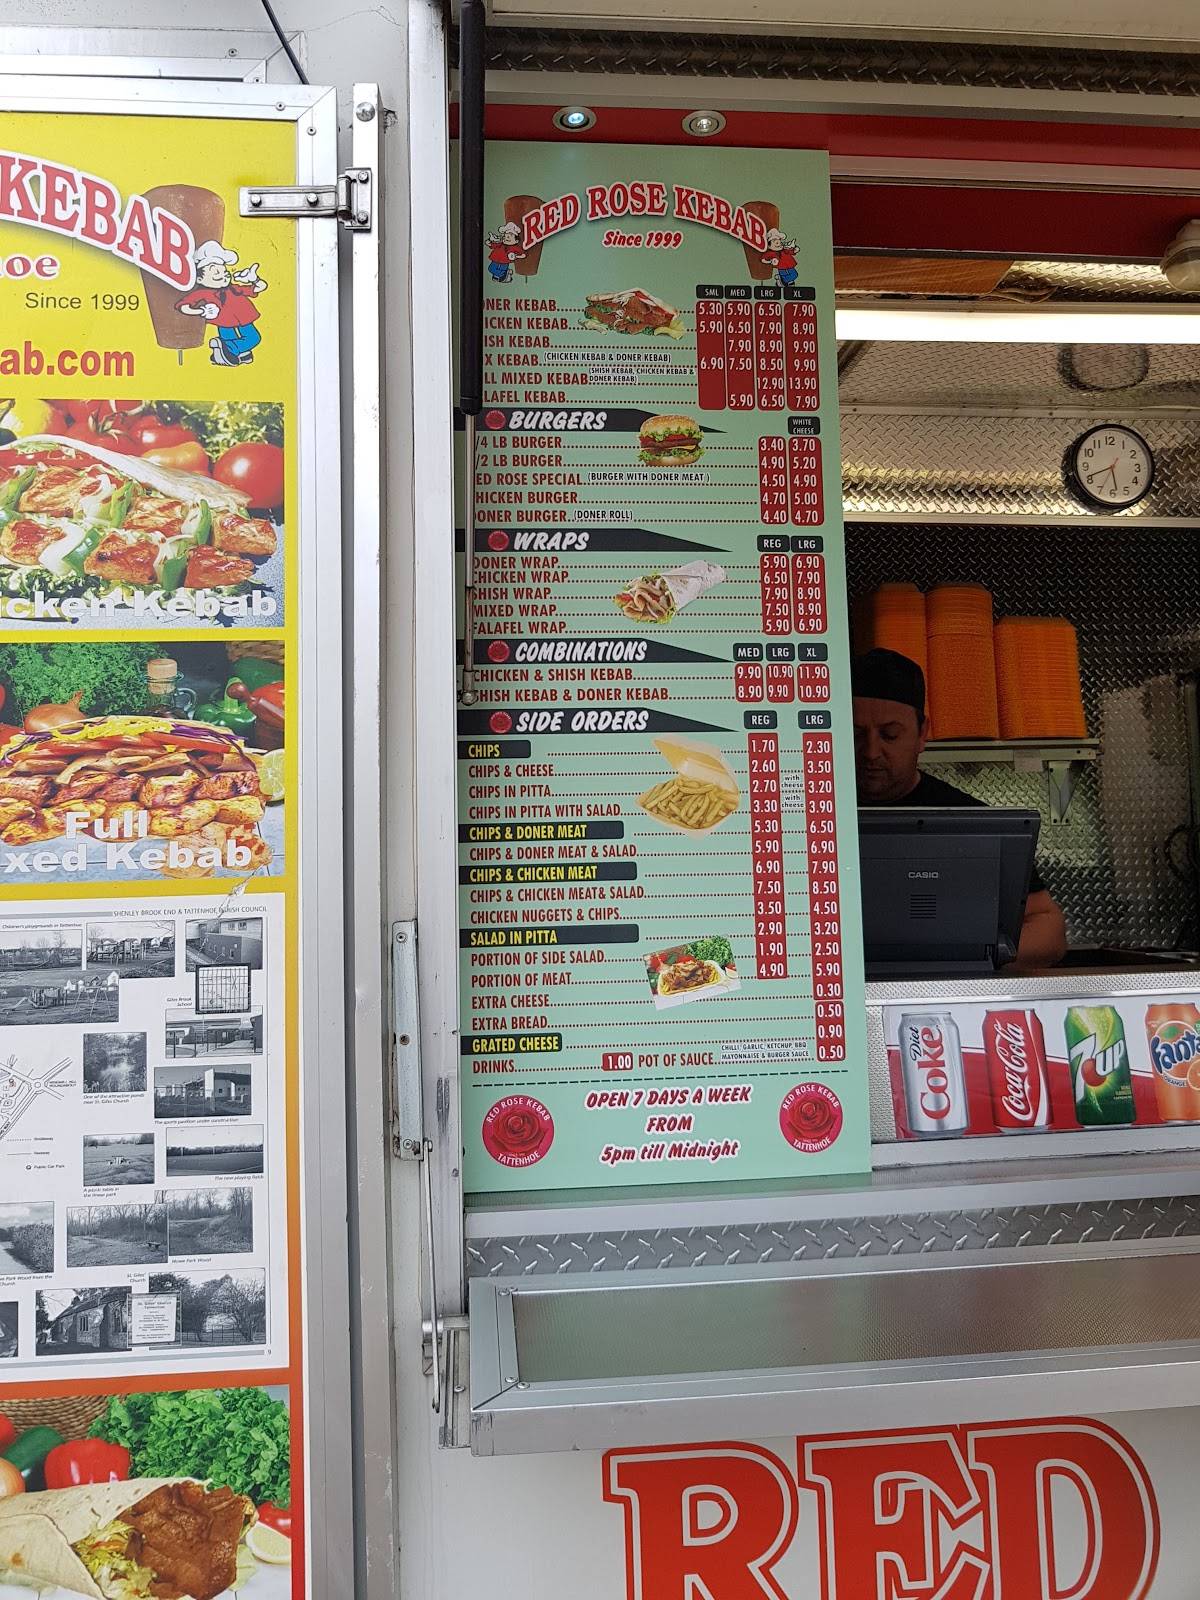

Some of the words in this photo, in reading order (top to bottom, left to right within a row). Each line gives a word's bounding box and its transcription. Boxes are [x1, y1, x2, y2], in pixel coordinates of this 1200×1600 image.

[0, 154, 191, 287] KEBAB
[523, 194, 581, 248] RED
[587, 182, 667, 219] ROSE
[674, 185, 767, 251] KEBAB
[604, 231, 641, 246] Since
[646, 232, 682, 247] 1999
[705, 288, 719, 296] SML
[731, 289, 745, 297] MED
[793, 290, 802, 298] XL
[25, 292, 81, 308] Since
[91, 294, 139, 310] 1999
[699, 303, 722, 315] 5.30
[727, 303, 750, 315] 5.90
[759, 304, 781, 316] 6.50
[792, 305, 814, 316] 7.90
[729, 340, 751, 352] 7.90
[760, 340, 782, 352] 8.90
[794, 341, 815, 353] 9.90
[544, 352, 578, 362] (CHICKEN
[581, 353, 605, 361] KEBAB
[608, 353, 613, 361] &
[616, 353, 642, 361] DONER
[644, 354, 670, 363] KEBAB)
[502, 372, 542, 384] MIXED
[548, 373, 588, 385] KEBAB
[757, 378, 784, 390] 12.90
[789, 378, 816, 390] 13.90
[509, 410, 607, 430] BURGERS
[493, 436, 507, 448] LB
[512, 436, 562, 449] BURGER
[760, 438, 784, 451] 3.40
[792, 439, 815, 451] 3.70
[1105, 436, 1115, 445] 12
[1084, 448, 1093, 457] 10
[497, 473, 528, 485] ROSE
[532, 473, 582, 486] SPECIAL
[588, 473, 624, 482] (BURGER
[627, 473, 648, 481] WITH
[651, 473, 679, 481] DONER
[682, 473, 704, 481] MEAT
[762, 474, 785, 487] 4.50
[794, 475, 817, 487] 4.90
[517, 510, 567, 522] BURGER
[574, 510, 607, 521] (DONER
[609, 510, 633, 520] ROLL)
[763, 510, 786, 523] 4.40
[795, 511, 818, 523] 4.70
[513, 532, 590, 551] WRAPS
[763, 539, 781, 549] REG
[798, 540, 816, 549] LRG
[474, 556, 516, 568] DONER
[521, 556, 558, 569] WRAP
[763, 556, 786, 568] 5.90
[797, 556, 820, 569] 6.90
[134, 590, 277, 618] Kebab
[474, 604, 513, 616] MIXED
[519, 604, 557, 616] WRAP
[765, 603, 789, 616] 7.50
[798, 603, 821, 615] 8.90
[515, 641, 648, 662] COMBINATIONS
[737, 648, 759, 657] MED
[772, 648, 789, 657] LRG
[806, 648, 817, 657] XL
[474, 669, 529, 682] CHICKEN
[534, 670, 543, 682] &
[548, 669, 586, 681] SHISH
[591, 668, 633, 681] KEBAB
[737, 666, 761, 679] 9.90
[768, 666, 793, 678] 10.90
[799, 666, 828, 679] 11.90
[516, 711, 564, 732] SIDE
[571, 710, 649, 732] ORDERS
[751, 715, 770, 725] REG
[806, 715, 823, 725] LRG
[468, 744, 500, 758] CHIPS
[752, 740, 775, 753] 1.70
[806, 741, 830, 753] 2.30
[469, 806, 501, 819] CHIPS
[505, 806, 516, 818] IN
[521, 805, 551, 818] PITTA
[555, 805, 583, 817] WITH
[587, 804, 621, 816] SALAD
[65, 810, 149, 840] Full
[106, 839, 252, 871] Kebab
[470, 910, 517, 924] CHICKEN
[522, 908, 573, 922] NUGGETS
[577, 908, 584, 920] &
[588, 907, 620, 920] CHIPS
[471, 952, 520, 967] PORTION
[525, 952, 538, 965] OF
[542, 951, 565, 964] SIDE
[569, 950, 604, 963] SALAD
[818, 1025, 842, 1038] 0.90
[472, 1038, 515, 1053] GRATED
[520, 1037, 559, 1051] CHEESE
[910, 1024, 921, 1061] Diet
[819, 1045, 843, 1059] 0.50
[473, 1060, 515, 1074] DRINKS
[607, 1055, 631, 1069] 1.00
[638, 1054, 660, 1067] POT
[663, 1053, 677, 1067] OF
[680, 1052, 714, 1066] SAUCE
[917, 1025, 951, 1120] Coke
[586, 1091, 629, 1108] OPEN
[632, 1091, 643, 1105] 7
[646, 1088, 689, 1106] DAYS
[692, 1088, 703, 1104] A
[708, 1086, 752, 1103] WEEK
[782, 1095, 795, 1110] RED
[795, 1085, 816, 1097] ROSE
[817, 1085, 839, 1108] KEBAB
[487, 1107, 500, 1123] RED
[501, 1098, 524, 1109] ROSE
[526, 1099, 550, 1121] KEBAB
[646, 1116, 693, 1132] FROM
[793, 1136, 831, 1151] TATTENHOE
[497, 1151, 540, 1166] TATTENHOE
[601, 1146, 635, 1165] 5pm
[641, 1144, 665, 1160] till
[668, 1141, 738, 1161] Midnight
[602, 1416, 1160, 1600] RED
